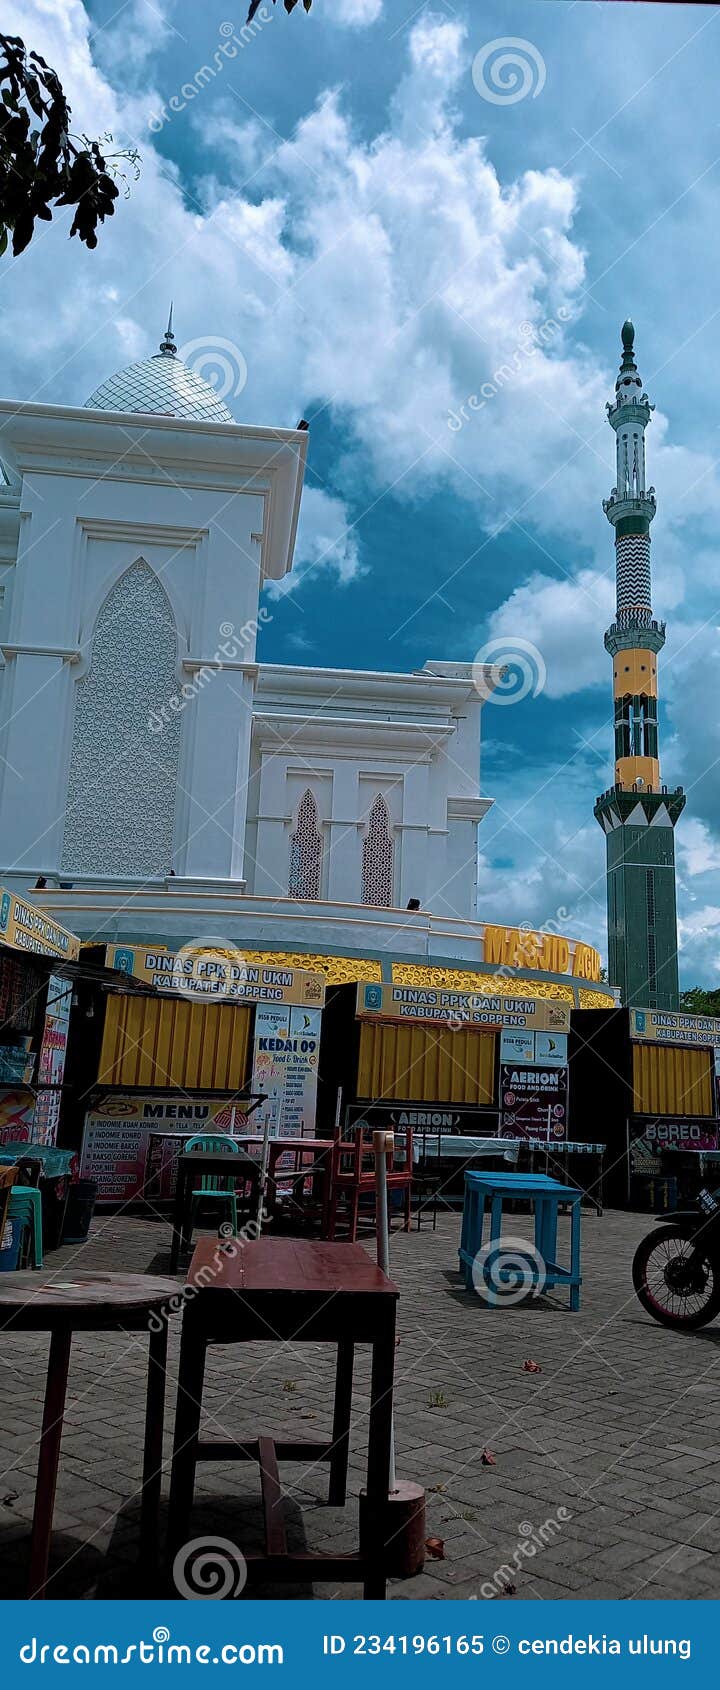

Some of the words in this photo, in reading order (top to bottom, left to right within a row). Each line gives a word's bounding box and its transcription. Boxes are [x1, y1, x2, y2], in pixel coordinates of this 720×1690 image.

[14, 902, 35, 930] DINAS
[484, 926, 569, 973] MASJID
[145, 955, 193, 974] DINAS
[197, 960, 227, 978] PPK
[230, 965, 259, 983] DAN
[263, 970, 293, 987] UKM
[153, 974, 227, 994] KABUPATEN
[229, 983, 283, 1000] SOPPENG
[392, 988, 437, 1005] DINAS
[441, 993, 470, 1008] PPK
[471, 996, 500, 1011] DAN
[504, 1000, 536, 1015] UKM
[400, 1005, 470, 1021] KABUPATEN
[473, 1012, 526, 1027] SOPPENG
[651, 1014, 677, 1027] DINAS
[679, 1017, 696, 1029] PPK
[697, 1018, 714, 1031] DAN
[656, 1028, 697, 1041] KABUPATEN
[259, 1038, 298, 1052] KEDAI
[301, 1040, 316, 1053] 09
[510, 1071, 559, 1085] AERION
[143, 1103, 209, 1119] MENU
[398, 1112, 452, 1126] AERION
